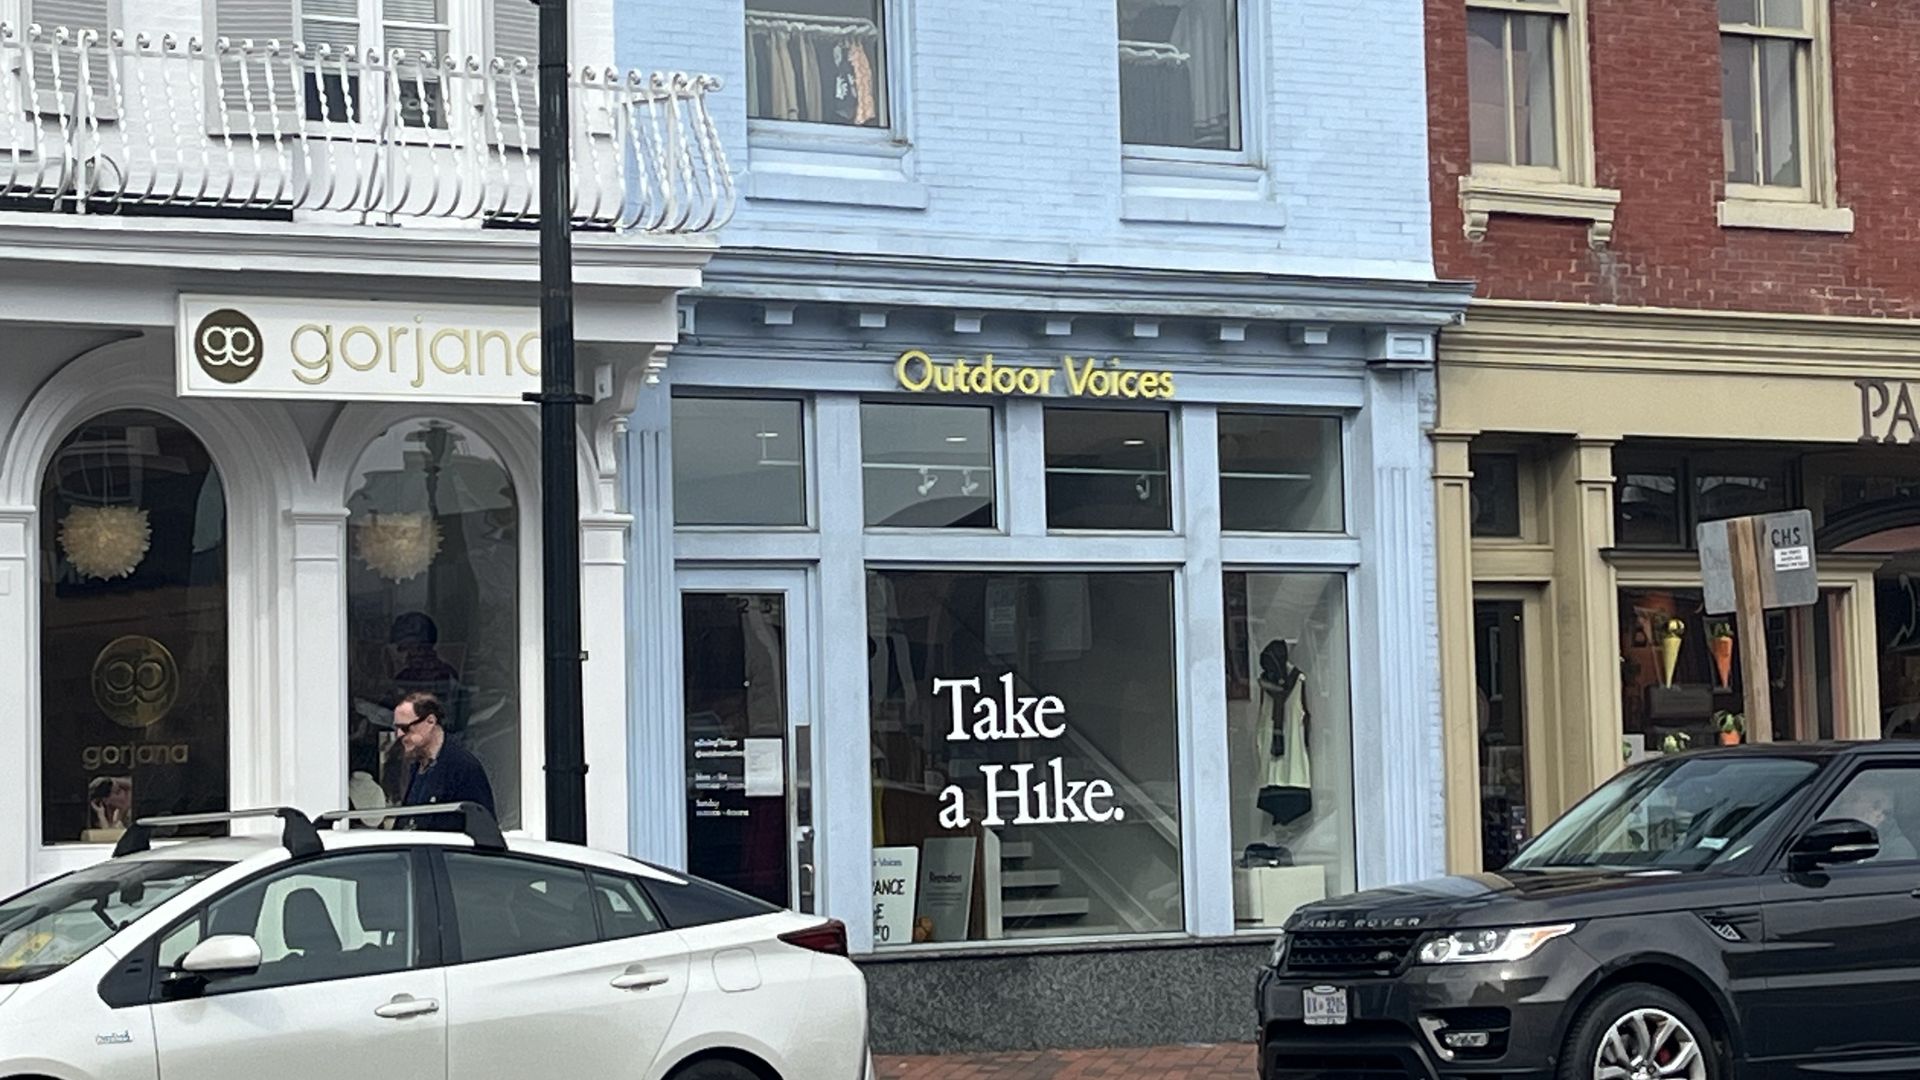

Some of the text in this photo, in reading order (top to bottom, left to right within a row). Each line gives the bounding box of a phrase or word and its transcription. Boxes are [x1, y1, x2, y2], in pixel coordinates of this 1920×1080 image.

[896, 350, 1176, 398] Outdoor Voices
[1854, 378, 1920, 445] PA
[1771, 527, 1801, 547] CHS
[932, 672, 1066, 740] Take
[81, 741, 189, 770] gorjana
[939, 757, 1125, 828] a Hike.
[873, 879, 905, 896] ANCE
[1354, 917, 1421, 928] ROVER
